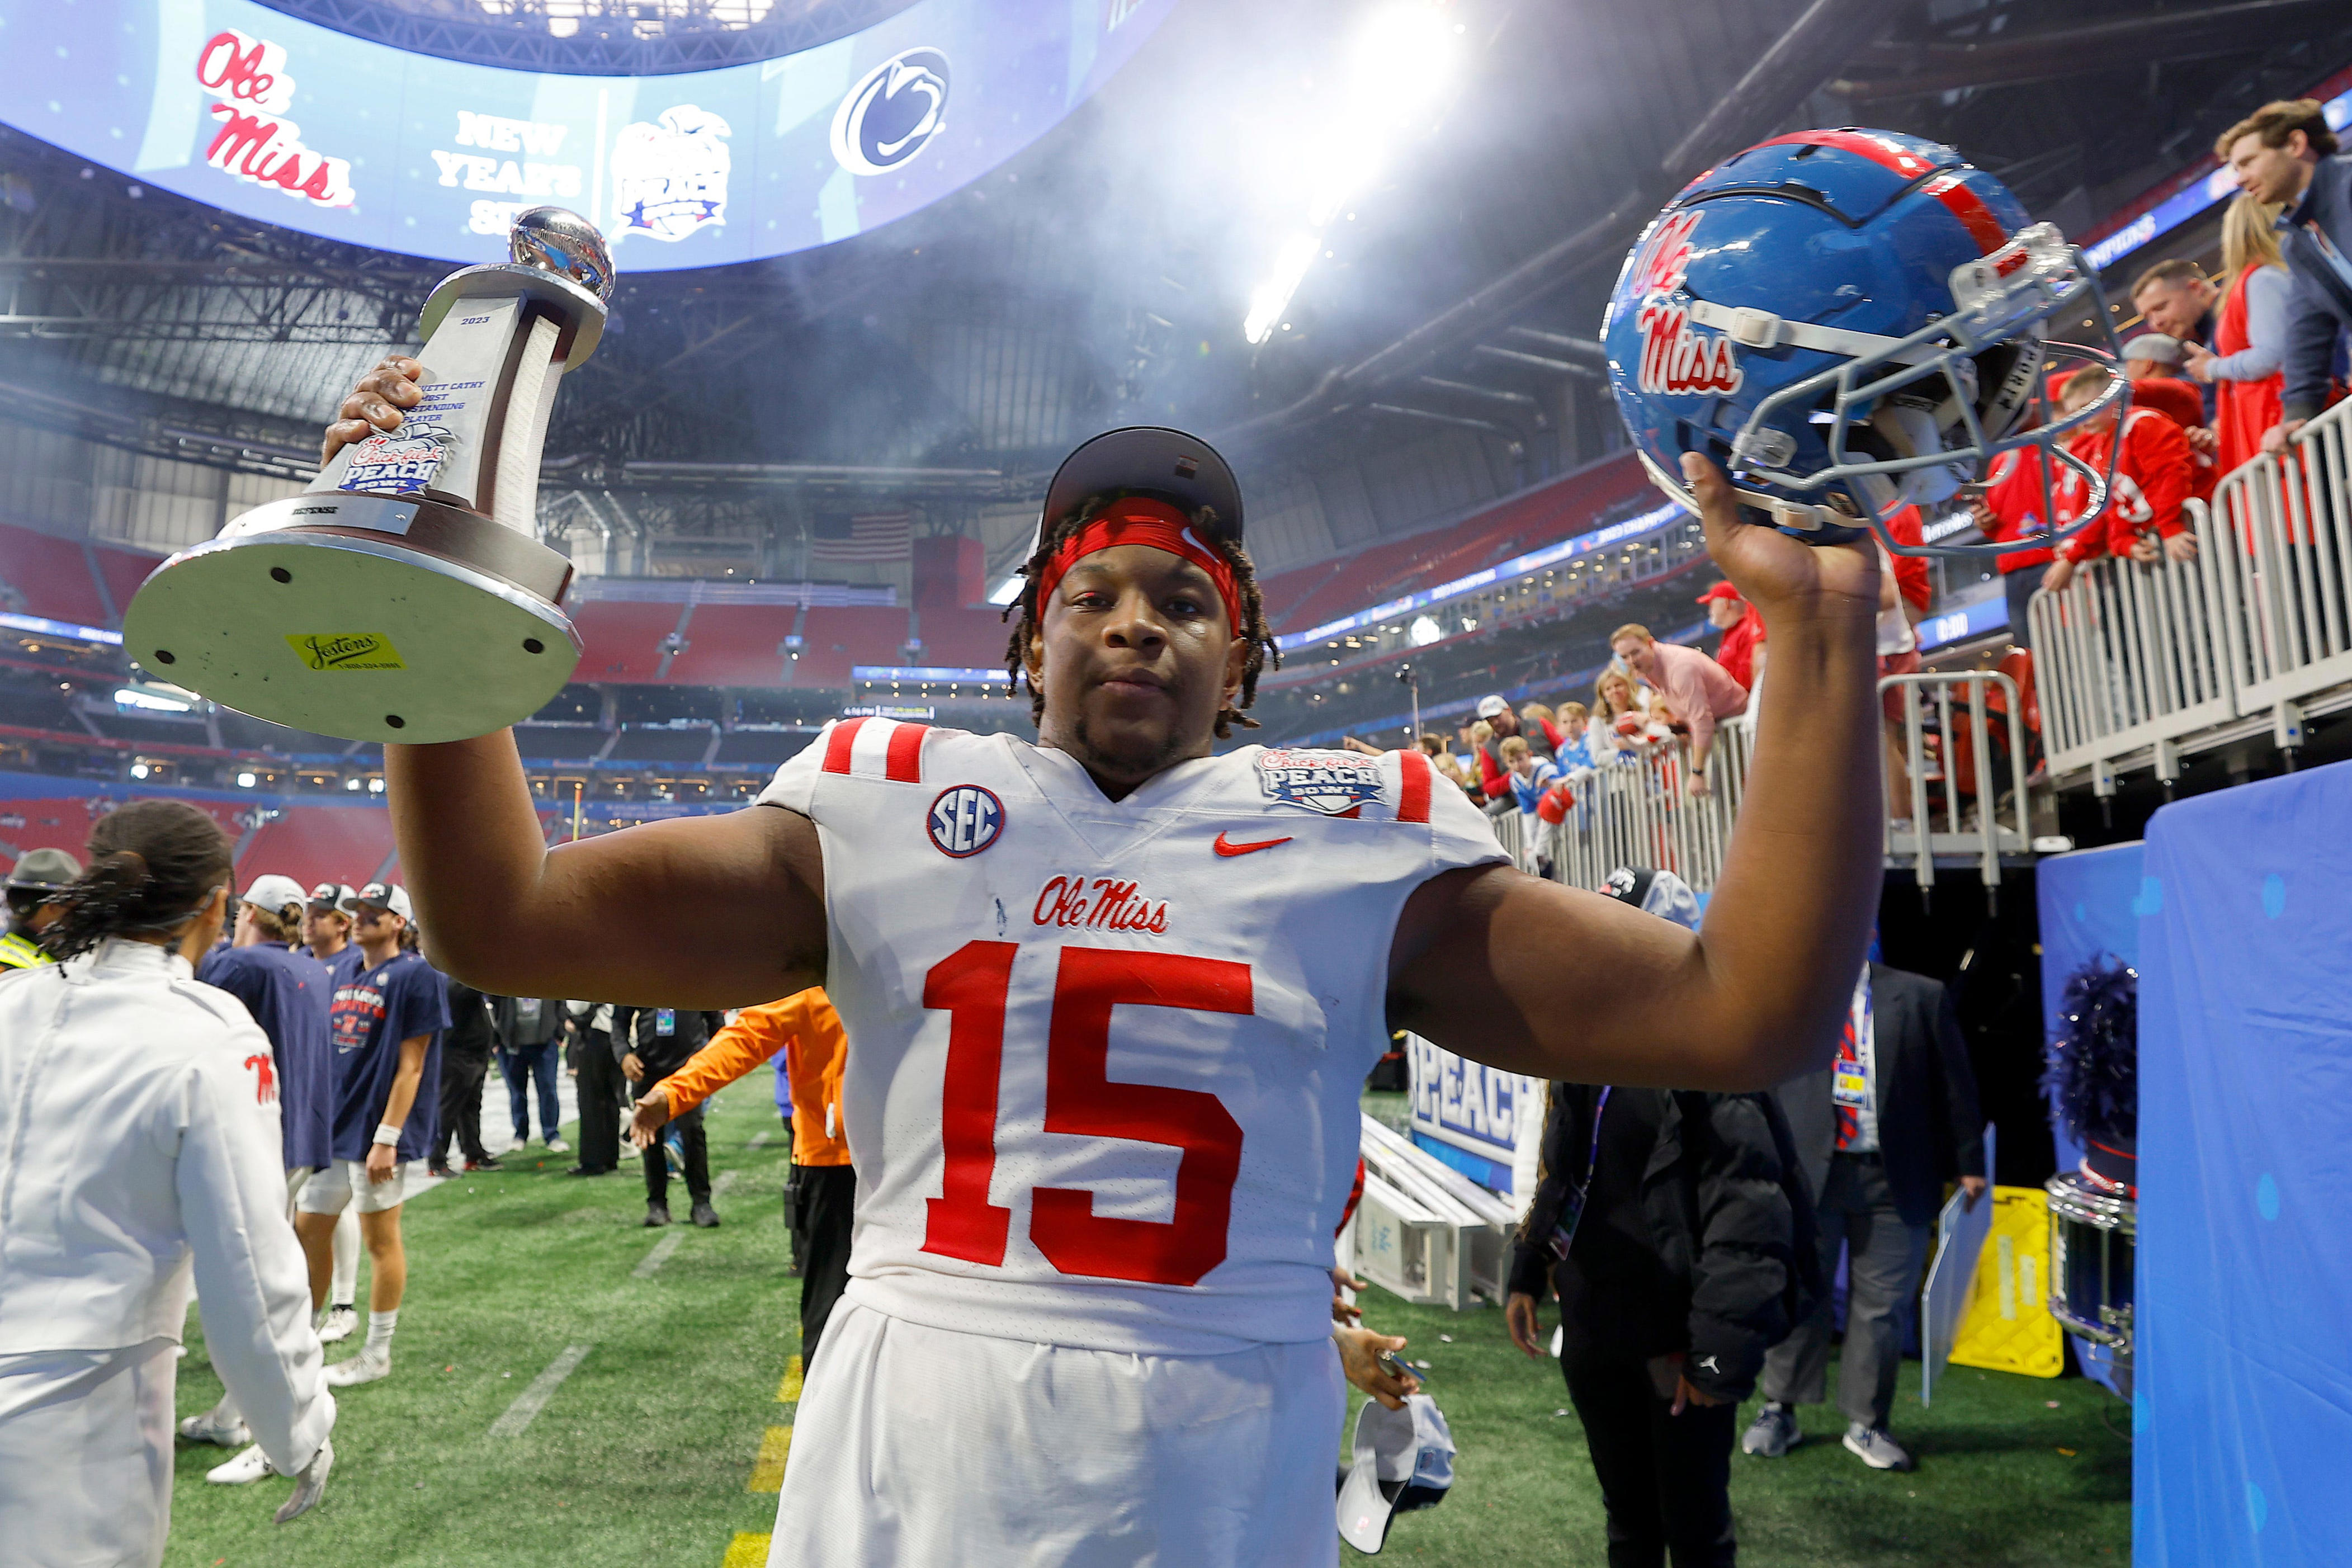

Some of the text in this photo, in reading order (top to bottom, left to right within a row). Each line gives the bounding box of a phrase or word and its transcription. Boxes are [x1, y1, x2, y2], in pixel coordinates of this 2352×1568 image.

[196, 32, 274, 105] Ole
[455, 110, 569, 157] NEW
[206, 104, 336, 201] Miss
[1632, 209, 1704, 298] Ole
[461, 317, 490, 325] 2023
[1639, 305, 1741, 394] Miss
[450, 381, 485, 390] CATHY
[402, 414, 442, 423] PLAYER
[407, 403, 465, 412] STANDING
[339, 462, 437, 485] PEACH
[353, 480, 409, 490] BOWL
[304, 635, 378, 670] Jostens
[1265, 768, 1381, 790] PEACH
[1290, 786, 1361, 796] BOWL
[932, 788, 998, 852] SEC
[1033, 875, 1169, 934] Ole Miss
[920, 940, 1255, 1286] 15
